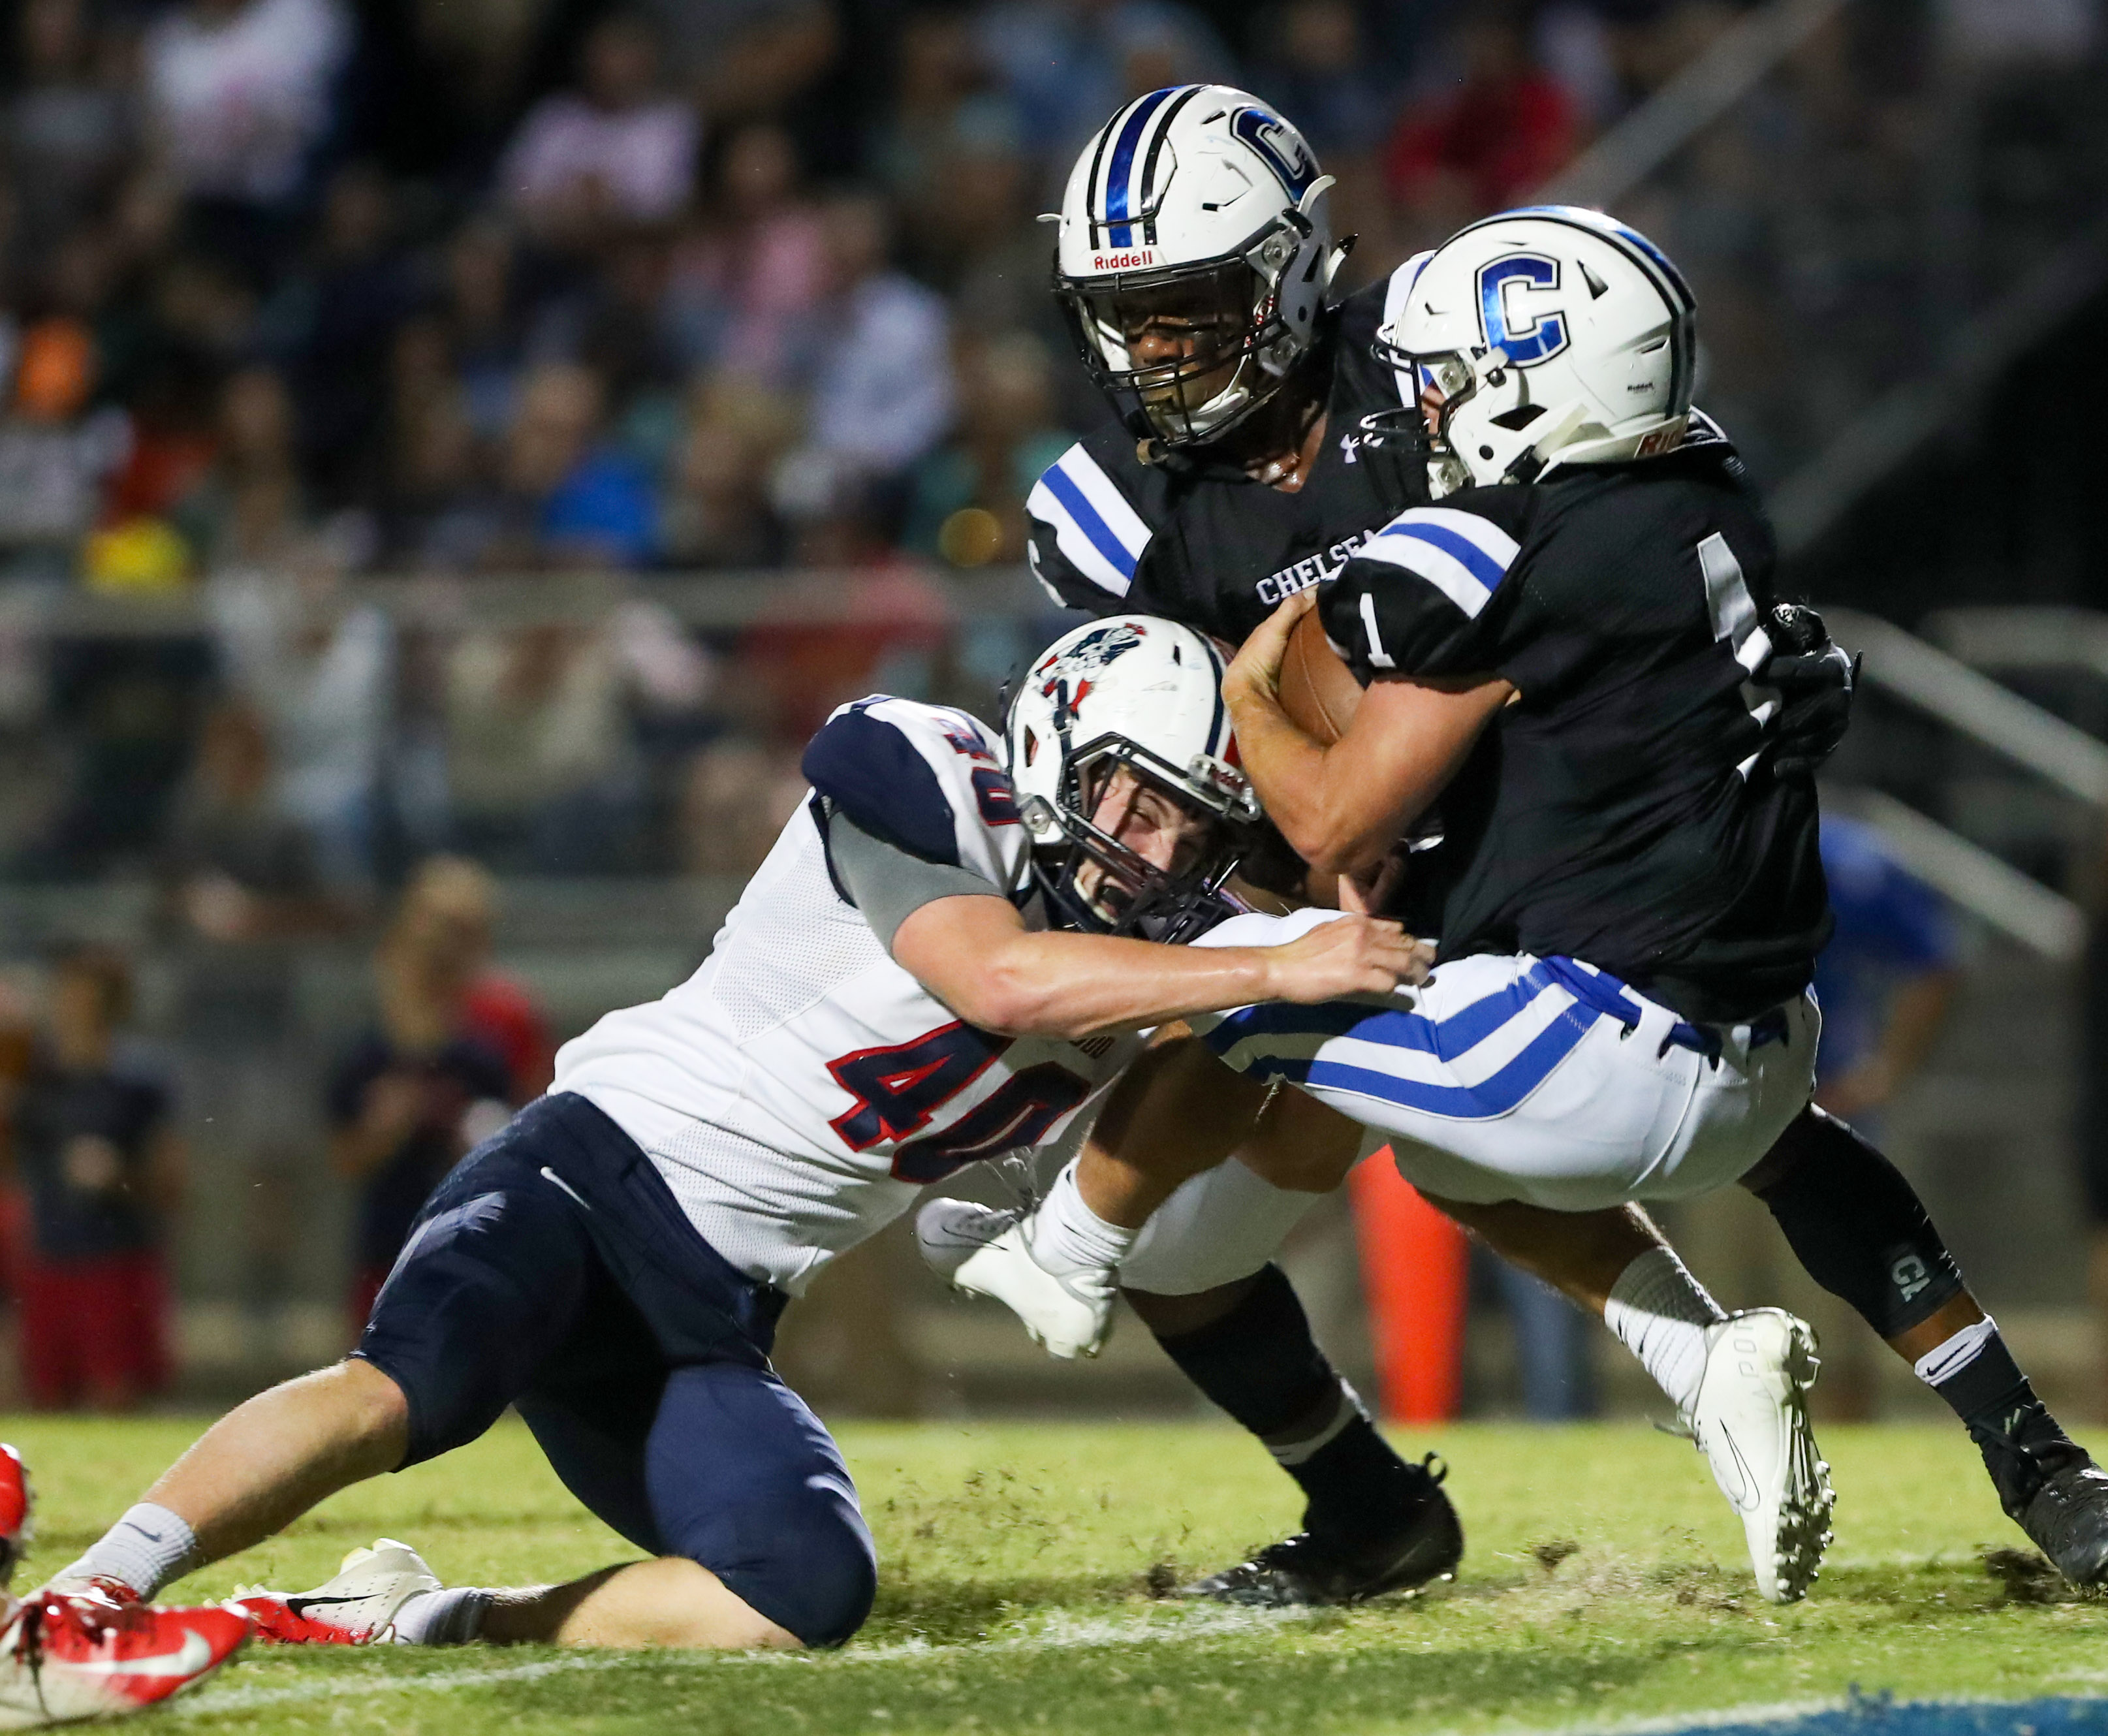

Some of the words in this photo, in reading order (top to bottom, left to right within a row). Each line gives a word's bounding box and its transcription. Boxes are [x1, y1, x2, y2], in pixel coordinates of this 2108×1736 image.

[1094, 251, 1152, 270] Riddell
[1475, 252, 1571, 368] C
[825, 1019, 1091, 1184] 40
